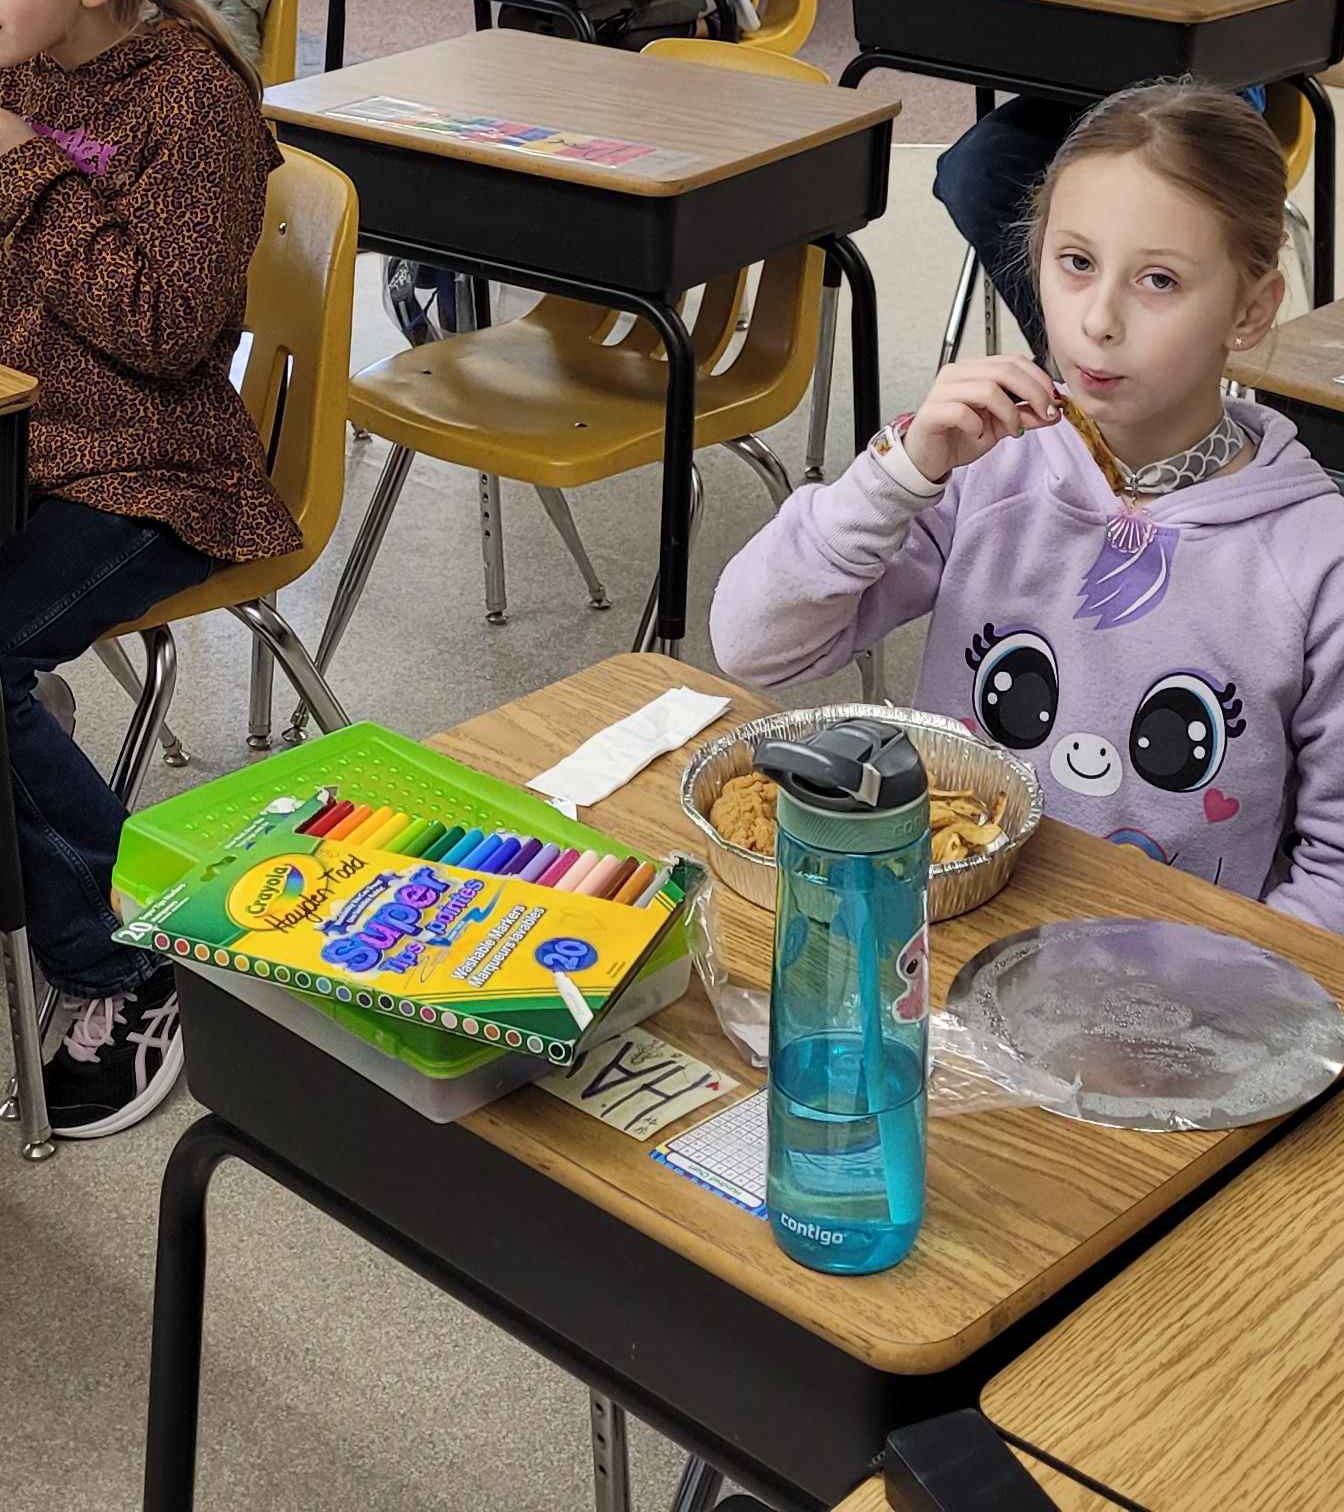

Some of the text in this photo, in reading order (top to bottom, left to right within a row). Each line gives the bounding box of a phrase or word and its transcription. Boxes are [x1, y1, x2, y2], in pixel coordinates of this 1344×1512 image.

[247, 863, 290, 916] Crayola
[265, 854, 369, 934] Hayden Todd
[118, 922, 154, 942] 20
[322, 866, 450, 973] Super
[452, 903, 527, 980] Washable Markers
[379, 940, 425, 974] Tips
[468, 905, 546, 989] Marqueurs lavables
[543, 938, 590, 970] 20
[780, 1212, 845, 1247] contigo
